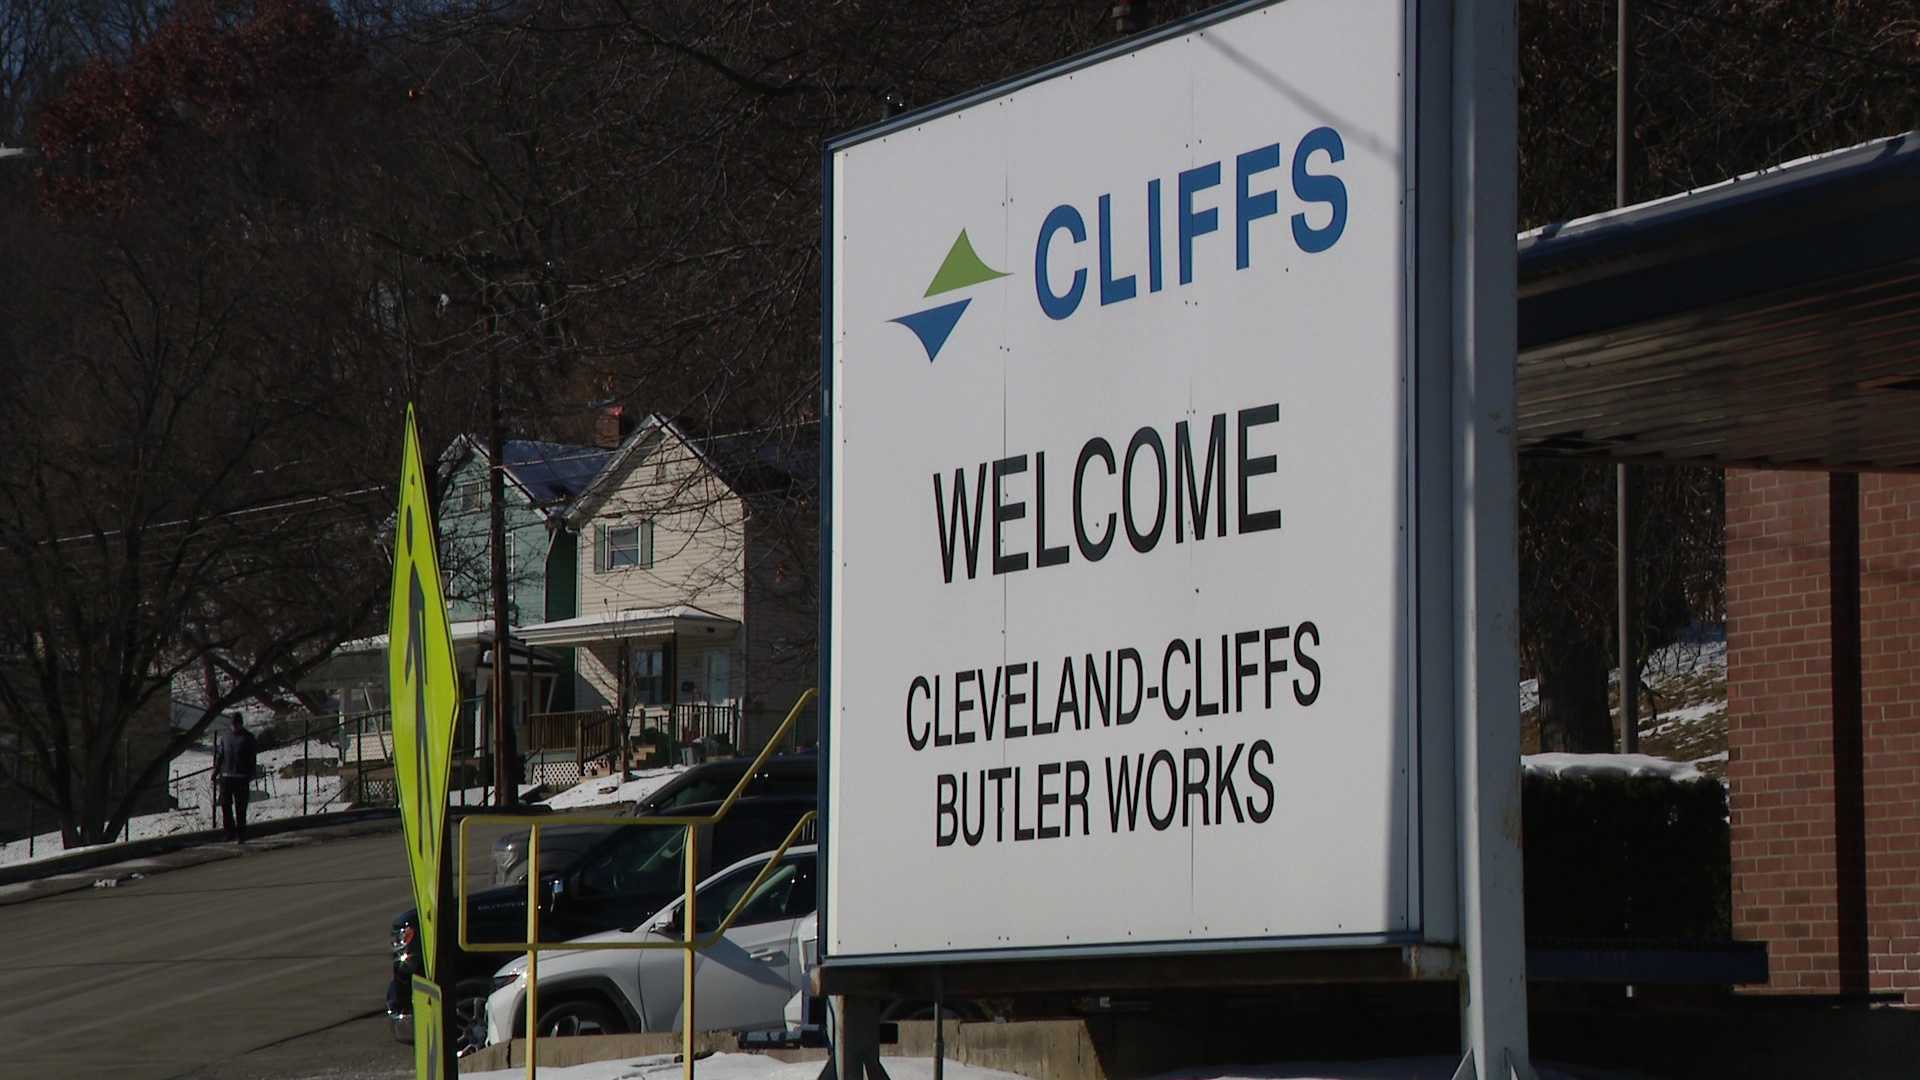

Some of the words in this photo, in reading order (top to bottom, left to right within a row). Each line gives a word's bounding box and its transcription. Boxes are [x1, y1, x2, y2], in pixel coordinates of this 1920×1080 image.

[1034, 126, 1348, 321] CLIFFS
[932, 402, 1282, 585] WELCOME
[906, 620, 1322, 752] CLEVELAND-CLIFFS
[936, 759, 1091, 848] BUTLER
[1104, 739, 1275, 834] WORKS
